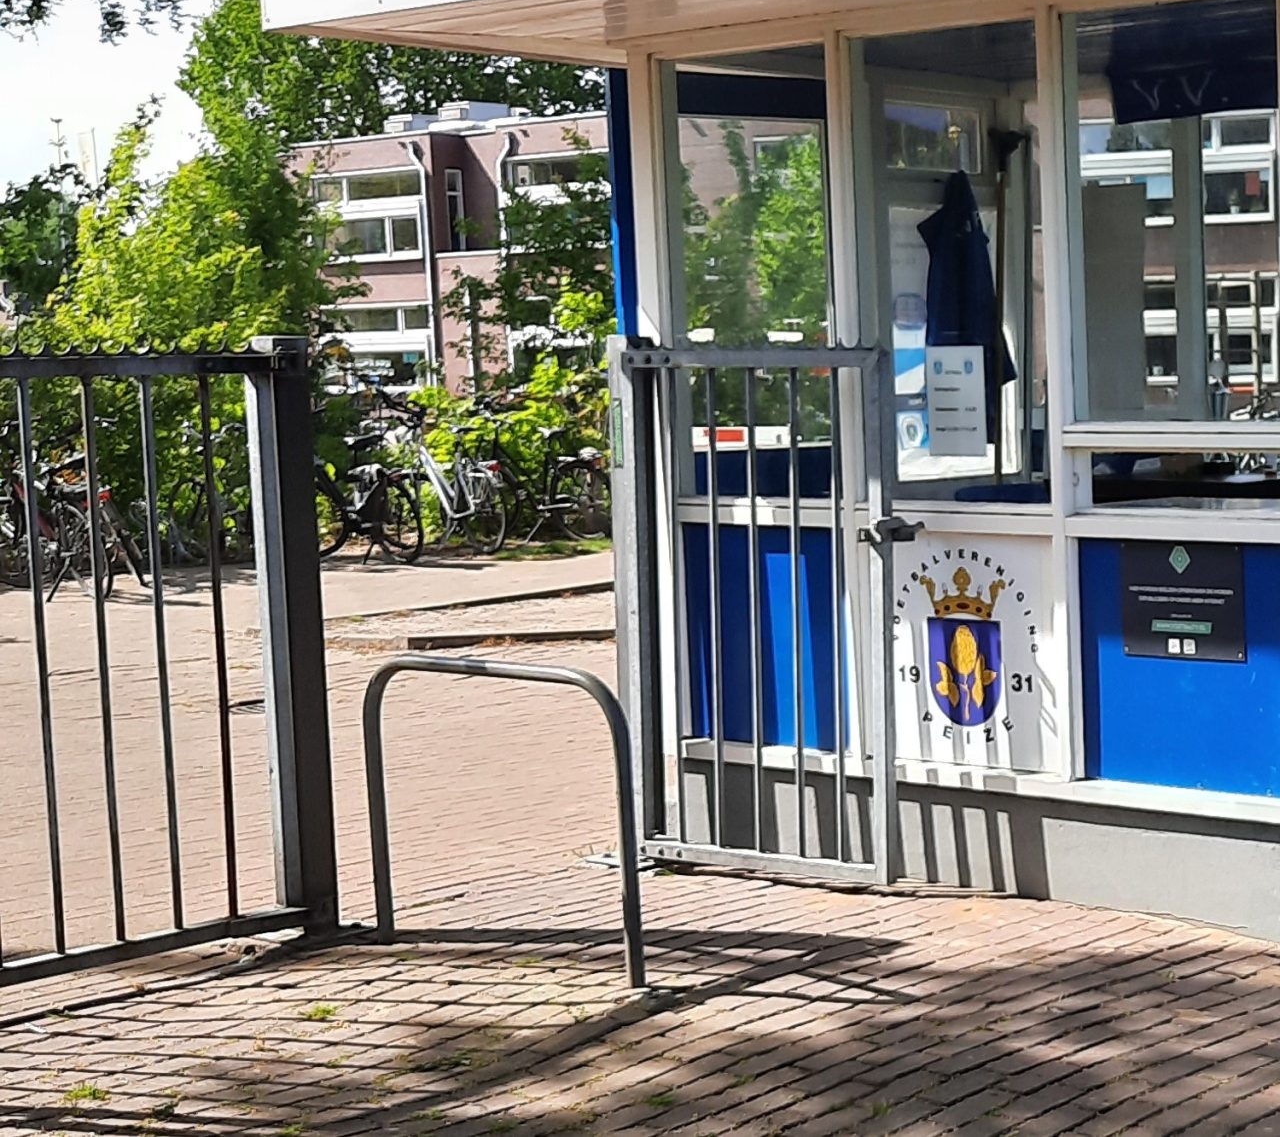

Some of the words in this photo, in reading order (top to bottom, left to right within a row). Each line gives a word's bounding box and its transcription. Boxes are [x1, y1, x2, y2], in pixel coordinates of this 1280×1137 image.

[898, 665, 921, 684] 19
[1011, 673, 1034, 693] 31
[922, 710, 1015, 745] PEIZE
